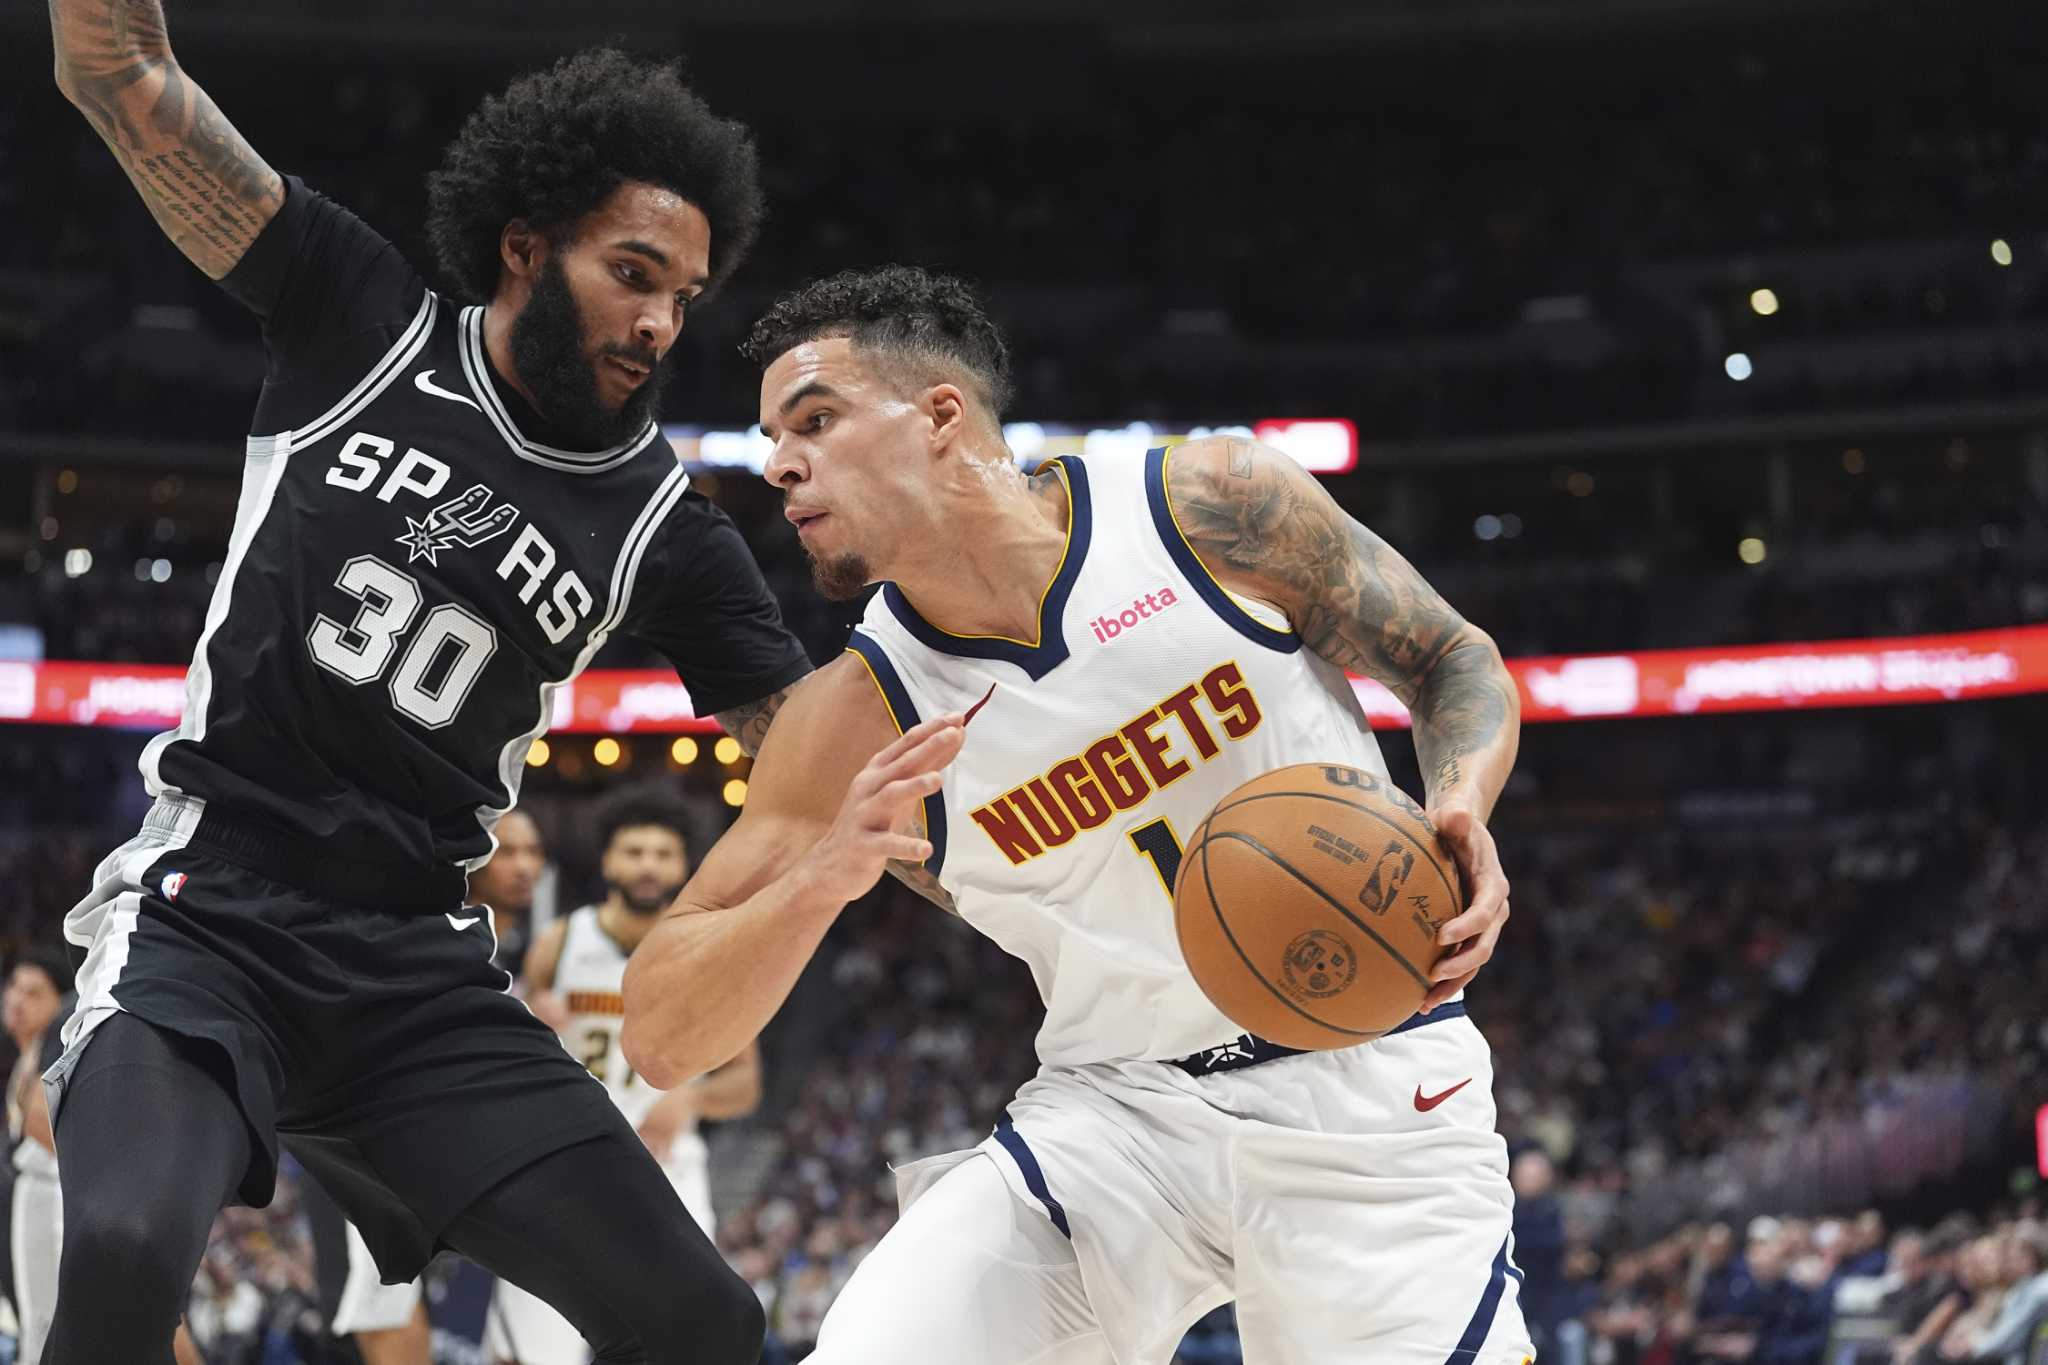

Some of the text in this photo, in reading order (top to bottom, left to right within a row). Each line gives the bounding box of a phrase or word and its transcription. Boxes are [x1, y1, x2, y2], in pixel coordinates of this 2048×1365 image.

[325, 431, 593, 645] SPURS
[1090, 586, 1178, 644] ibotta
[305, 554, 498, 731] 30
[969, 659, 1263, 865] NUGGETS
